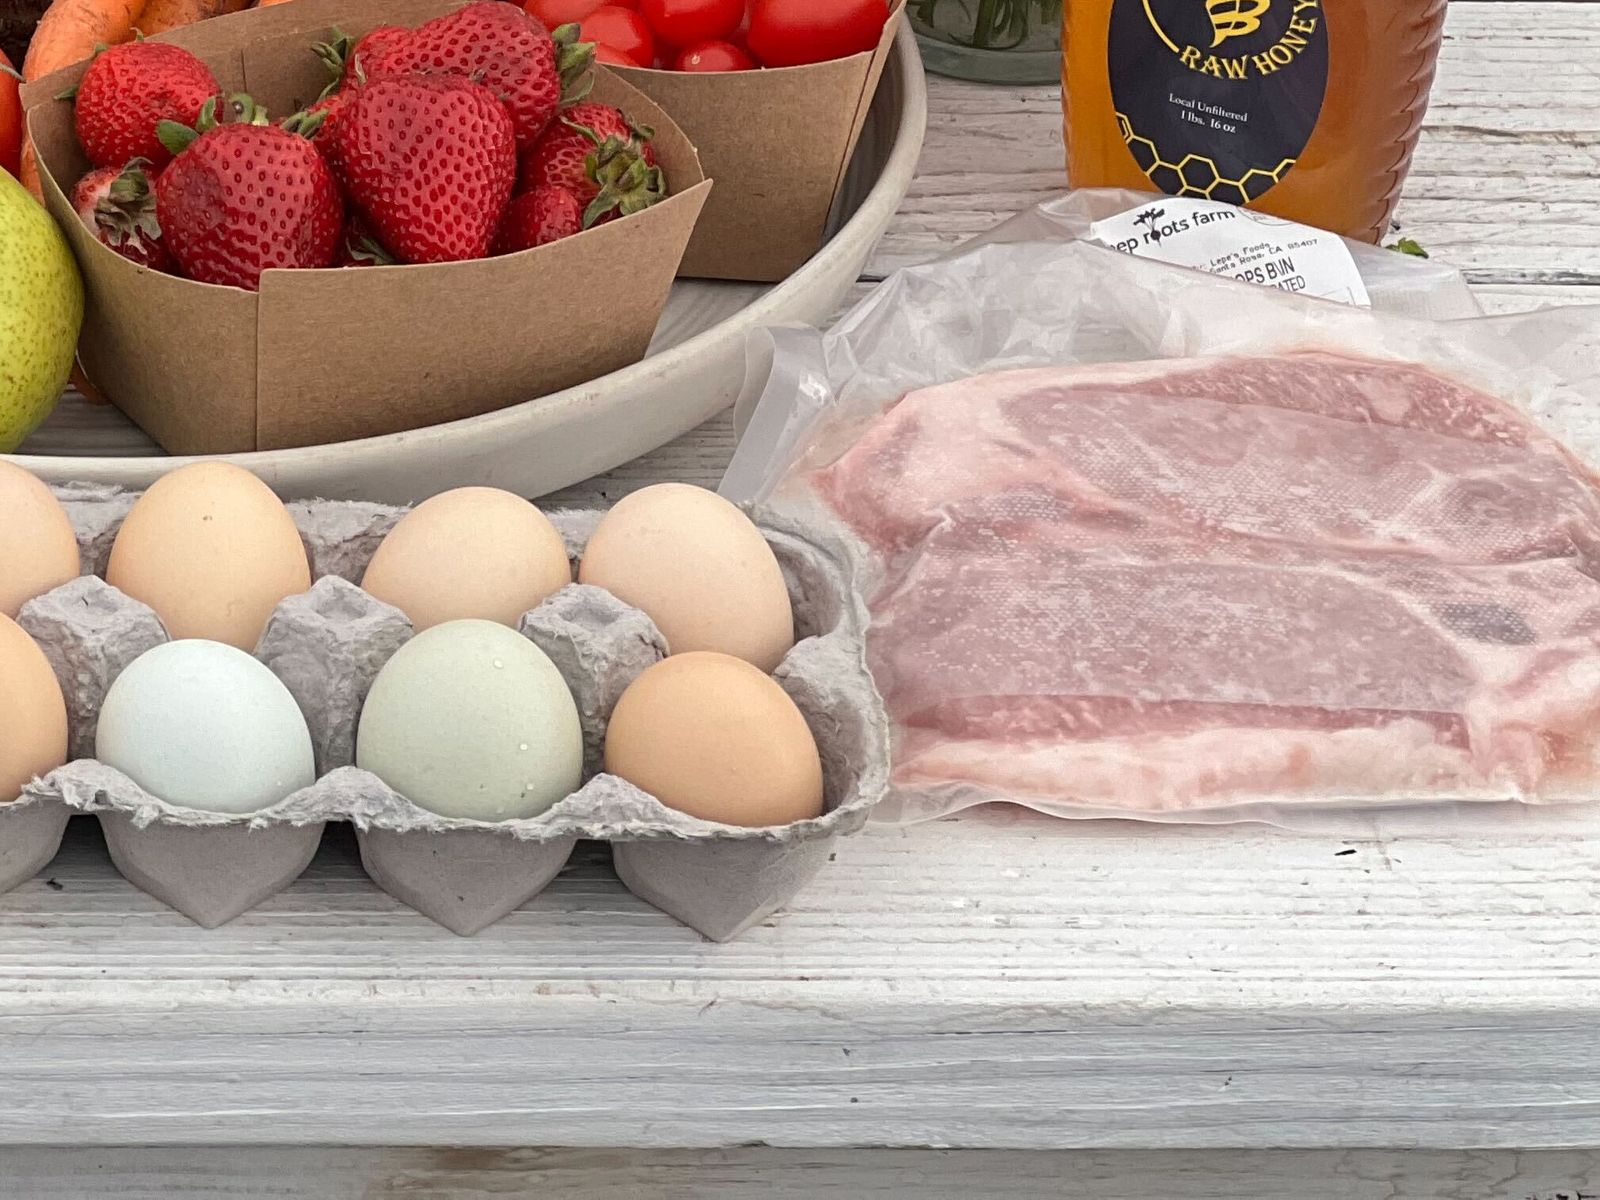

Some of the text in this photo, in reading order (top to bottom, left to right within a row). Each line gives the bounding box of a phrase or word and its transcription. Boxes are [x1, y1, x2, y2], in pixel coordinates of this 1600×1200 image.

[1179, 44, 1249, 80] RAW
[1168, 92, 1248, 122] Local Unfiltered
[1187, 111, 1206, 126] lbs.
[1210, 118, 1221, 130] 16
[1222, 123, 1237, 134] oz
[1111, 237, 1139, 255] ep
[1192, 210, 1236, 227] farm
[1209, 252, 1240, 267] Lepe's
[1242, 242, 1271, 255] Foods
[1268, 245, 1283, 256] CA
[1271, 275, 1306, 292] ATED
